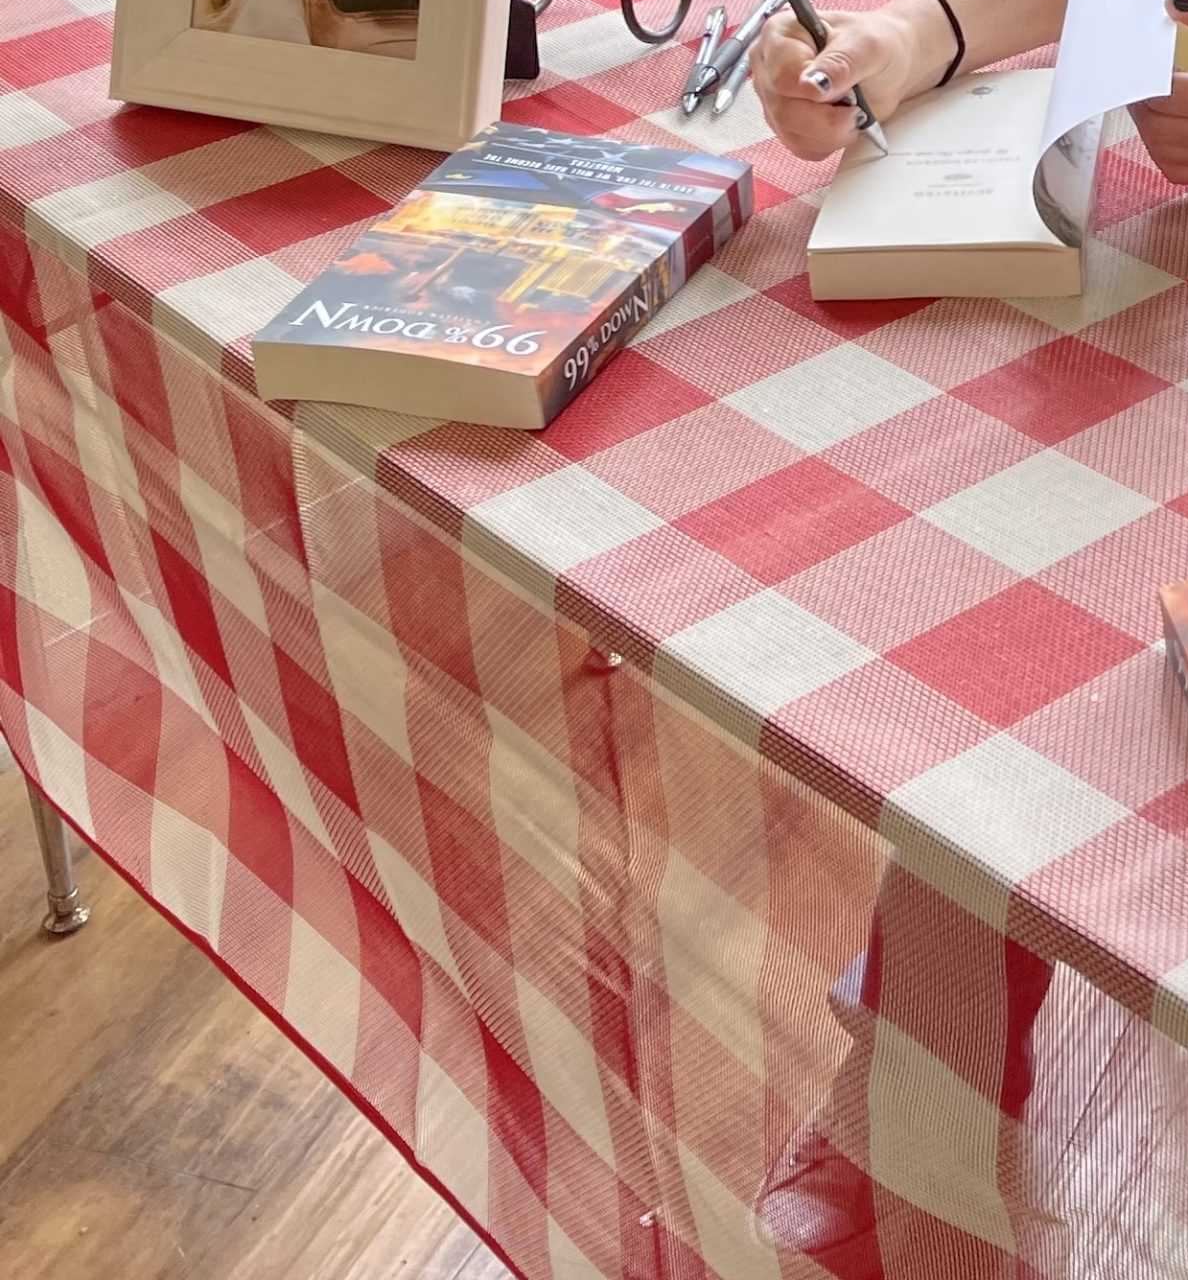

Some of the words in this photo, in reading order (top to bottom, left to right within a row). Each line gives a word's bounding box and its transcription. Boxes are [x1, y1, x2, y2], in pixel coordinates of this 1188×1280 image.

[287, 298, 439, 341] DOWN
[442, 323, 549, 357] 99%
[564, 335, 600, 392] 99%
[599, 281, 651, 345] DOWN
